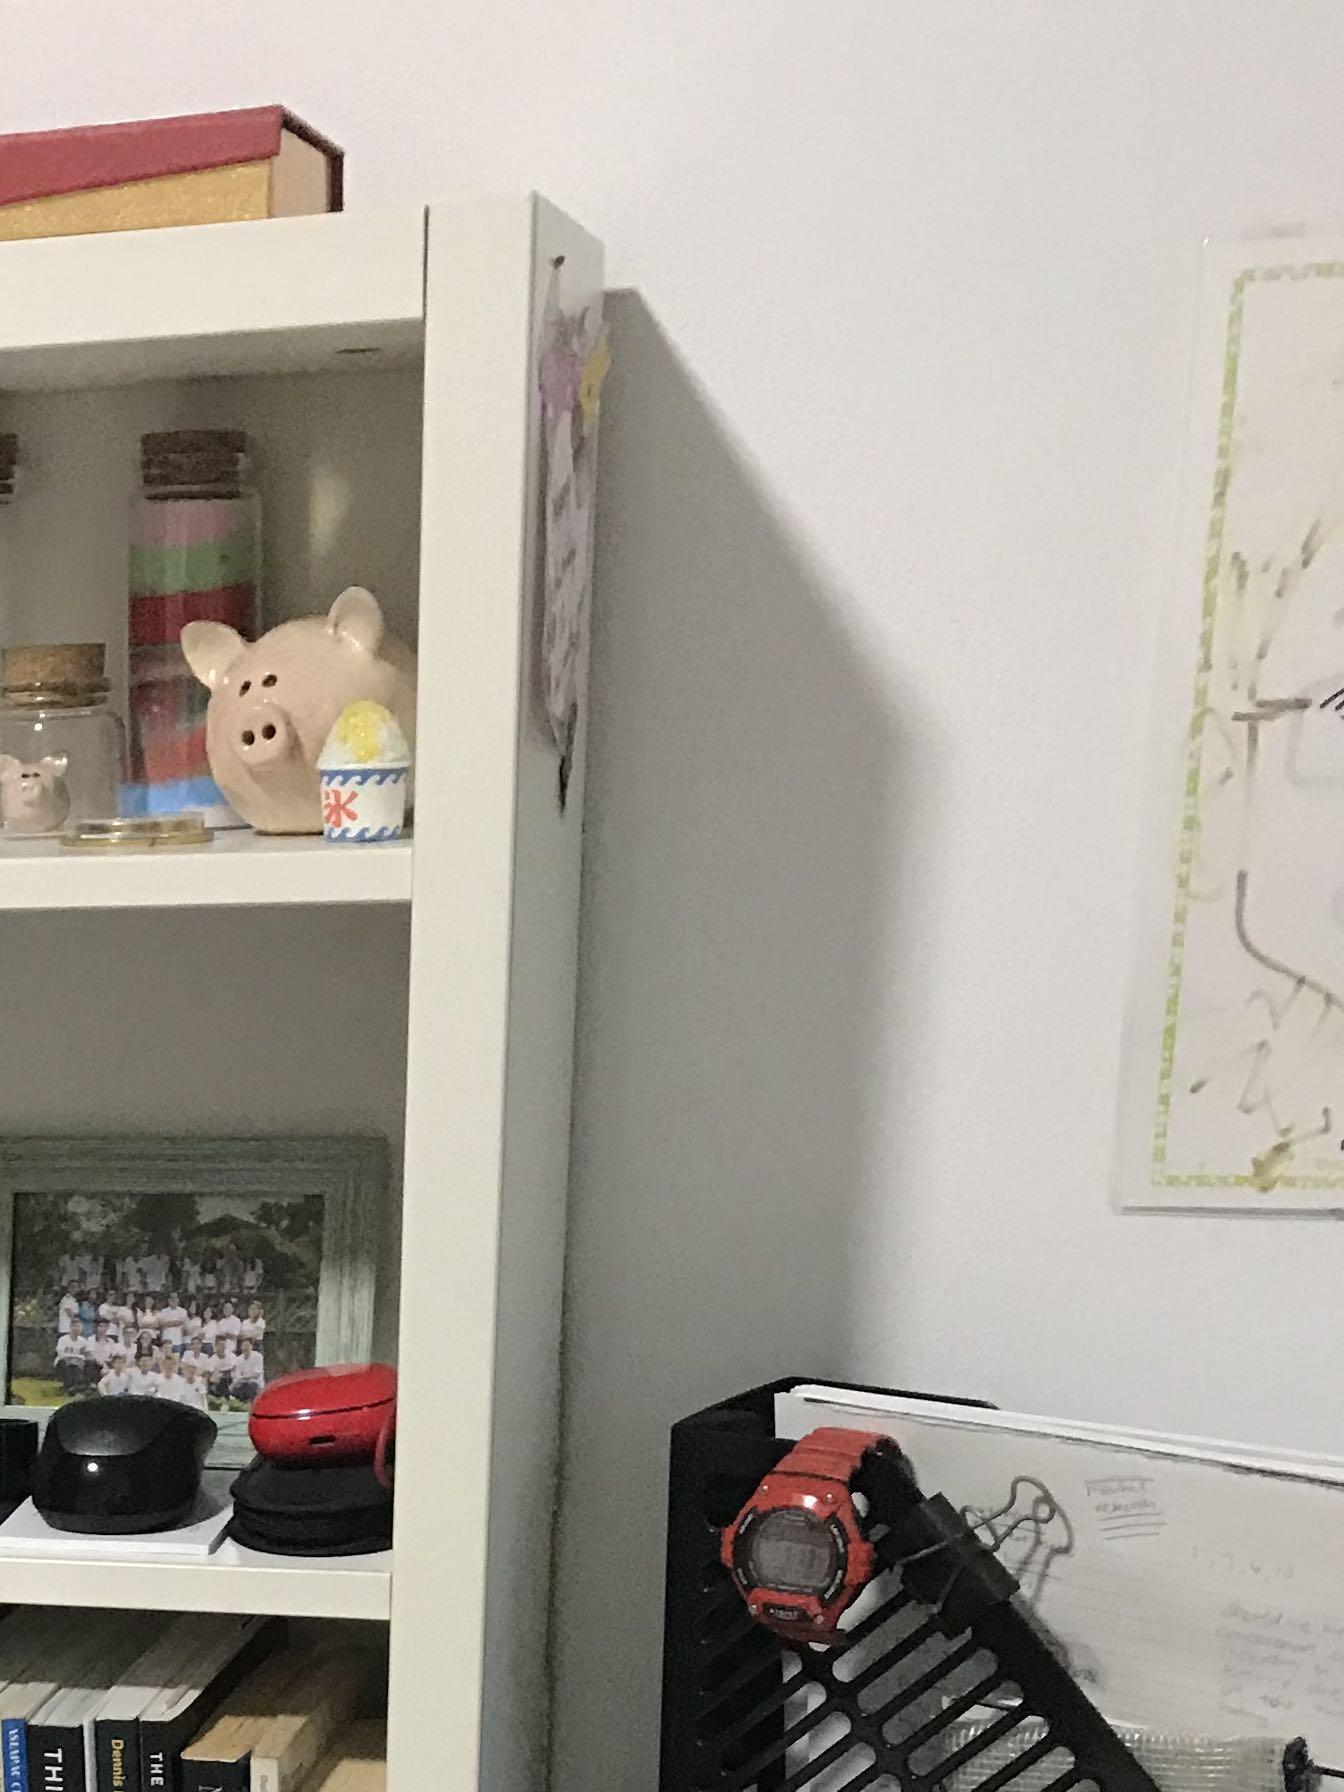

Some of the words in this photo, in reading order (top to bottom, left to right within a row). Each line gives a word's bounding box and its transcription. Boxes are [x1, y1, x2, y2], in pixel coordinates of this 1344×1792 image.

[8, 1728, 21, 1777] ASIAPAC
[111, 1739, 126, 1787] Dennis
[150, 1752, 164, 1786] THE
